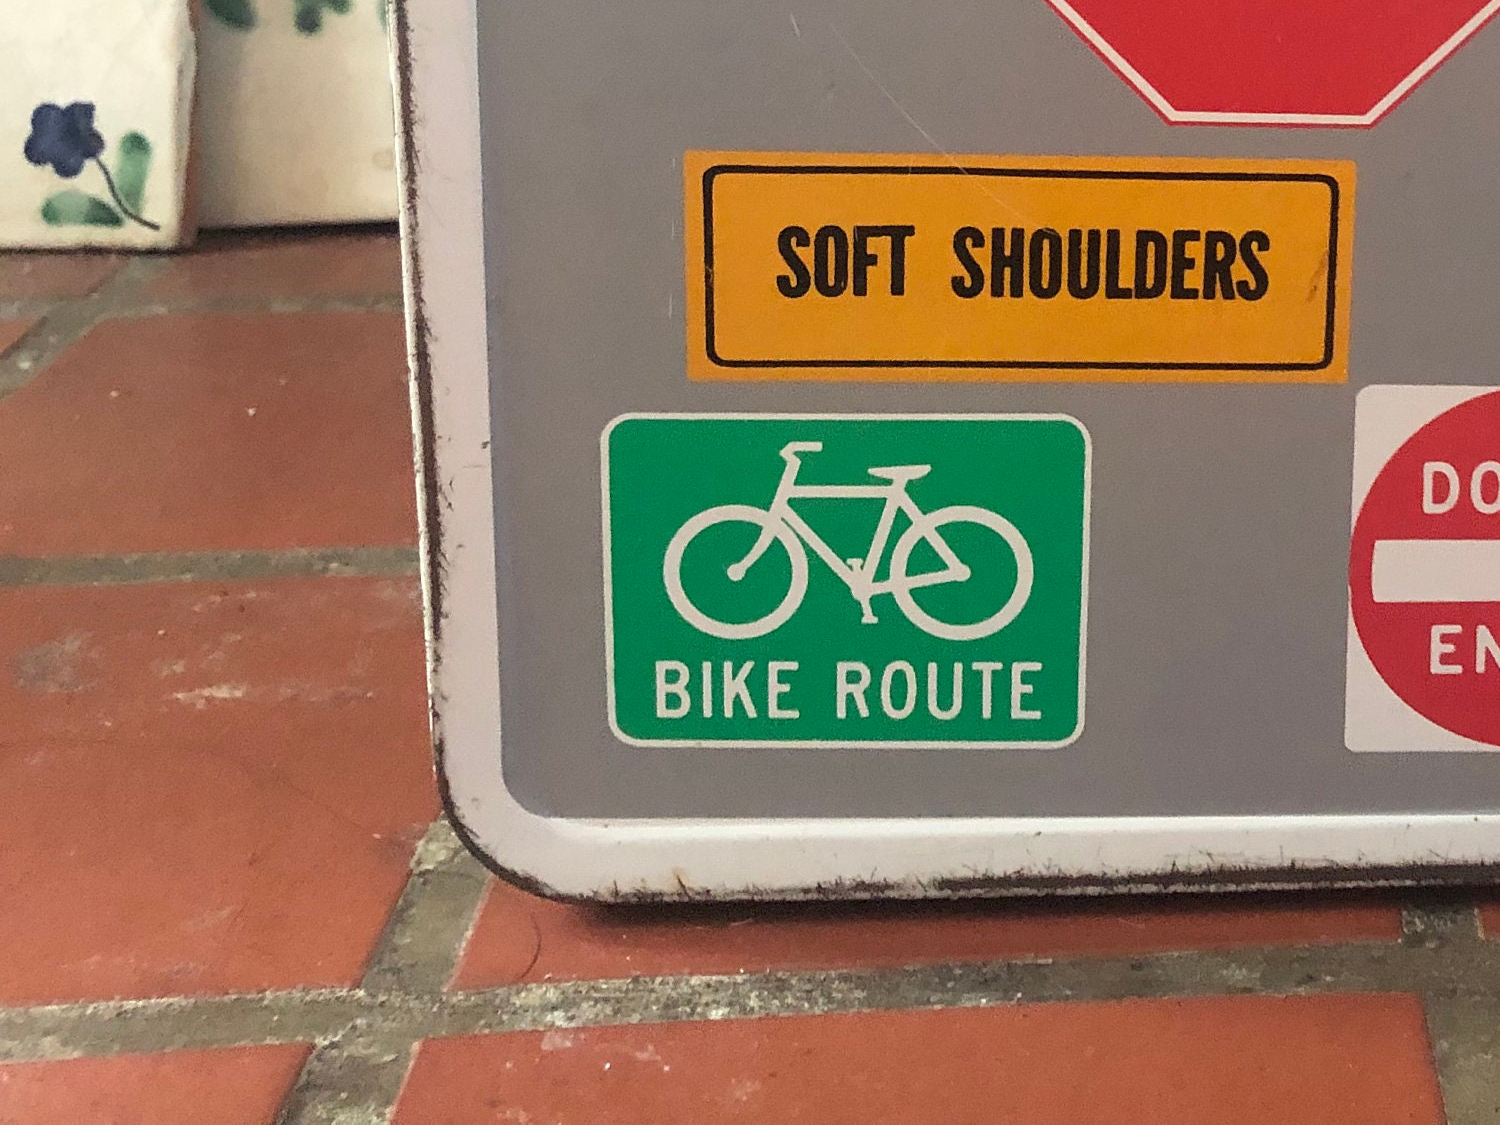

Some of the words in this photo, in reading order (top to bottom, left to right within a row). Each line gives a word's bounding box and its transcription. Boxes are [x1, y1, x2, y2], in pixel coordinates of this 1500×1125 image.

[777, 225, 915, 298] SOFT
[951, 226, 1270, 301] SHOULDERS
[656, 661, 799, 719] BIKE
[837, 660, 1042, 720] ROUTE
